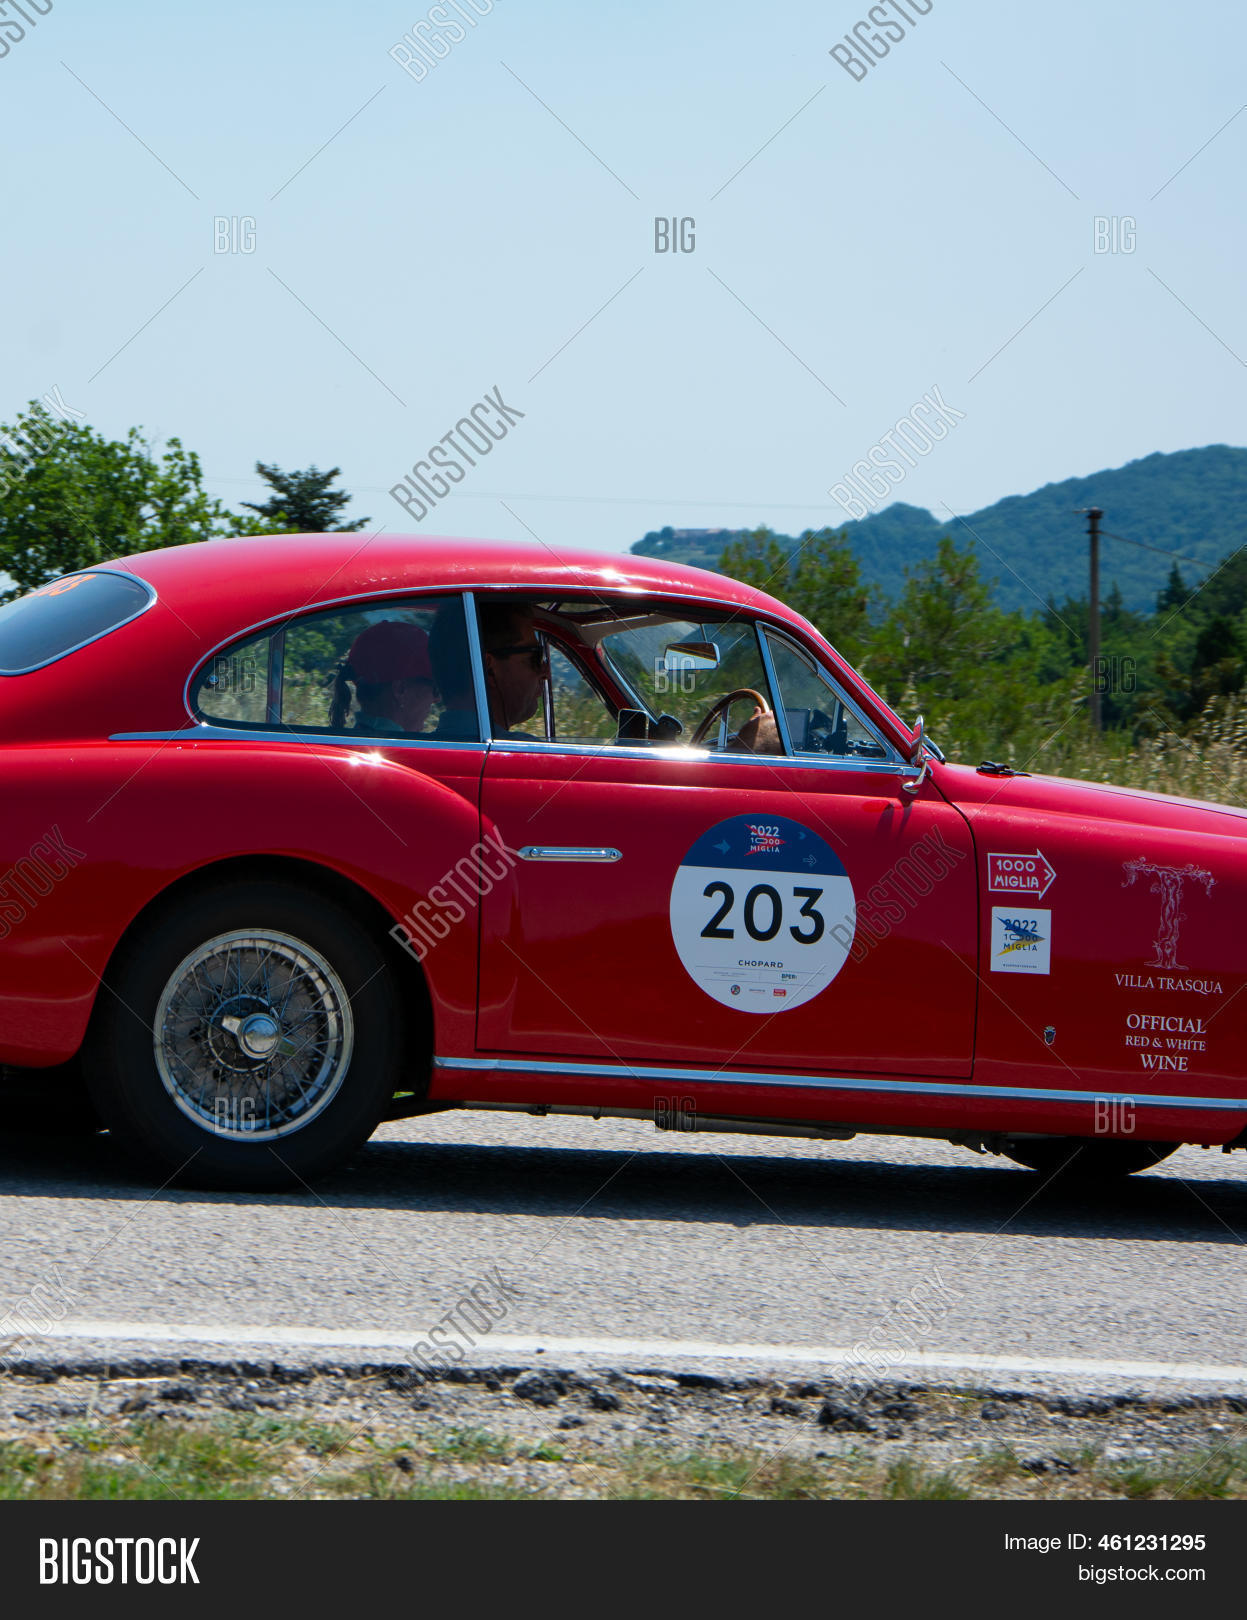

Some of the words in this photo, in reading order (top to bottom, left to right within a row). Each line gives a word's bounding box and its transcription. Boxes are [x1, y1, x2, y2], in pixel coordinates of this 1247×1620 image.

[750, 824, 780, 837] 2022
[750, 845, 780, 853] MIGLIA
[996, 859, 1036, 872] 1000
[994, 874, 1039, 888] MIGLIA
[700, 881, 825, 944] 203
[1003, 918, 1038, 933] 2022
[1003, 943, 1038, 952] MIGLIA
[738, 959, 784, 969] CHOPARD
[1115, 973, 1154, 989] VILLA
[1157, 977, 1223, 995] TRASQUA
[1126, 1013, 1207, 1034] OFFICIAL
[1125, 1035, 1150, 1047] RED
[1152, 1037, 1163, 1048] &
[1166, 1038, 1206, 1051] WHITE
[1140, 1053, 1189, 1072] WINE
